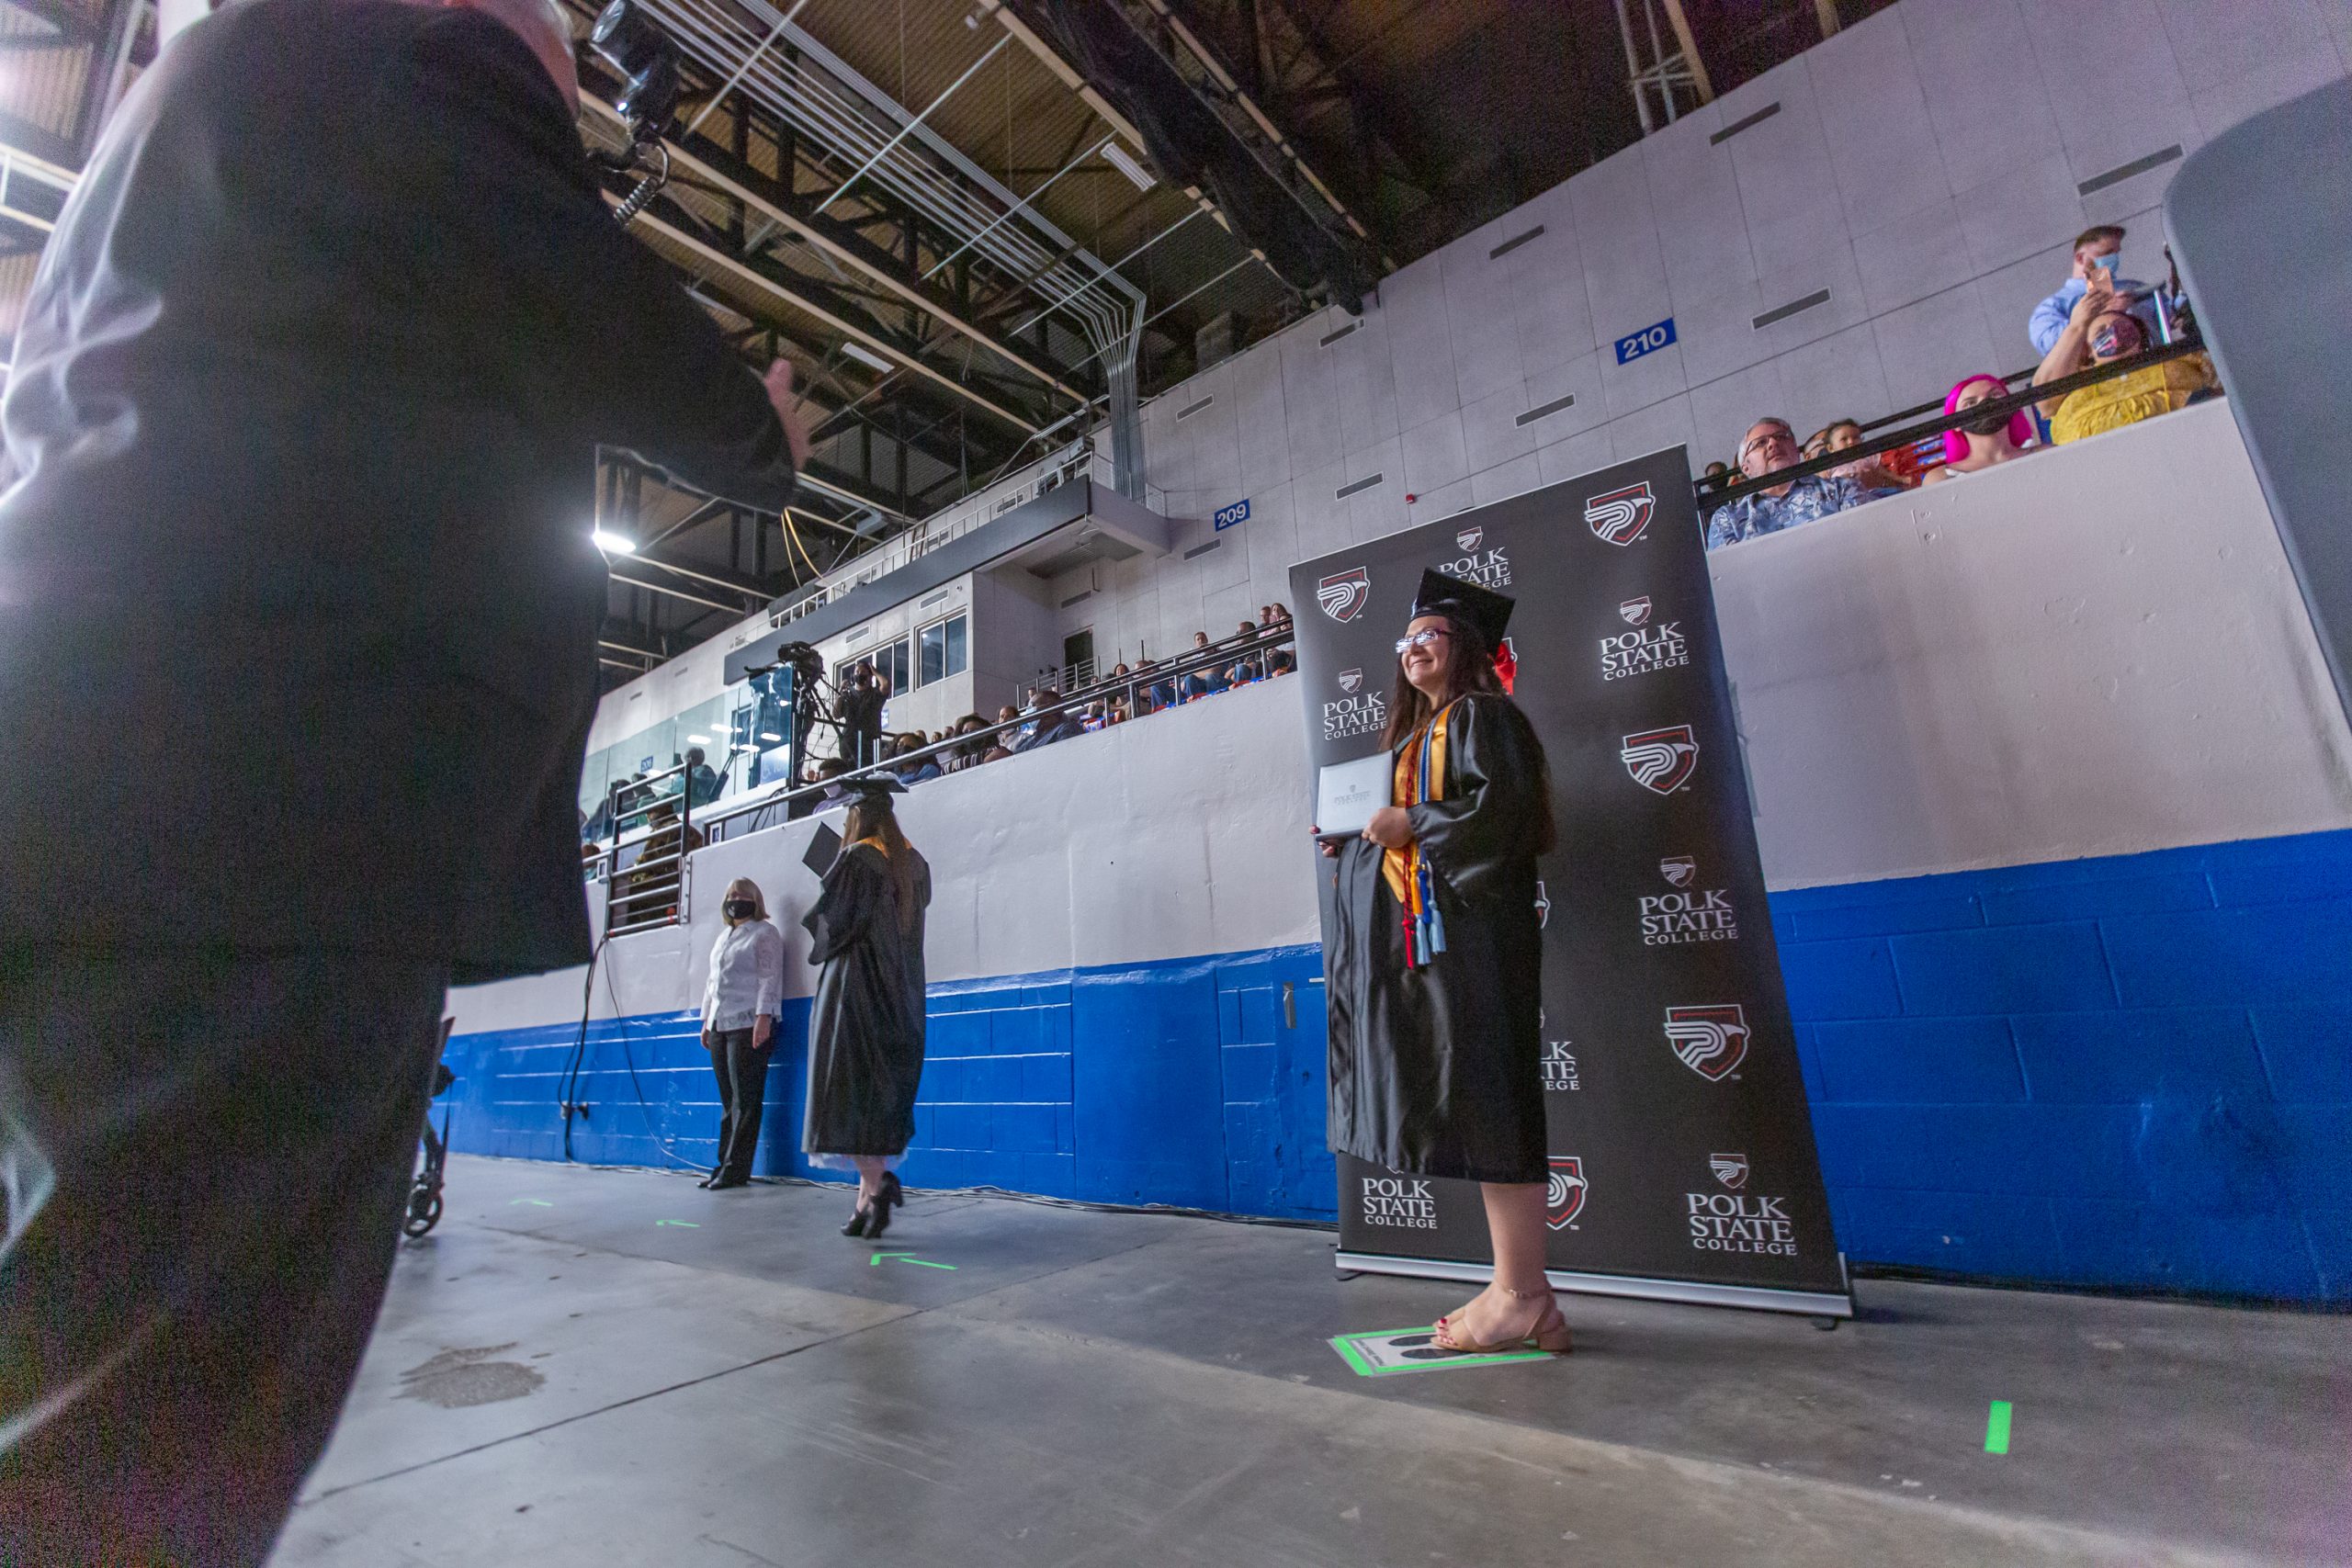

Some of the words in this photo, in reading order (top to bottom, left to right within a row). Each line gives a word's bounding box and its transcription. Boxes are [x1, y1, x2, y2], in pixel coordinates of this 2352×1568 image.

[1623, 326, 1667, 359] 210
[1217, 503, 1246, 528] 209
[1439, 547, 1509, 573] POLK
[1455, 561, 1510, 583] ATE
[1599, 621, 1685, 655] POLK
[1601, 638, 1688, 672] STATE
[1603, 656, 1690, 681] COLLEGE
[1323, 691, 1385, 717] POLK
[1324, 705, 1386, 732] STATE
[1325, 720, 1387, 740] COLLEGE
[1638, 889, 1733, 915] POLK
[1642, 908, 1736, 935] STATE
[1644, 929, 1738, 945] COLLEGE
[1362, 1178, 1434, 1199] POLK
[1363, 1196, 1436, 1218] STATE
[1686, 1193, 1791, 1219] POLK
[1364, 1215, 1438, 1229] COLLEGE
[1690, 1215, 1794, 1242] STATE
[1693, 1238, 1798, 1256] COLLEGE
